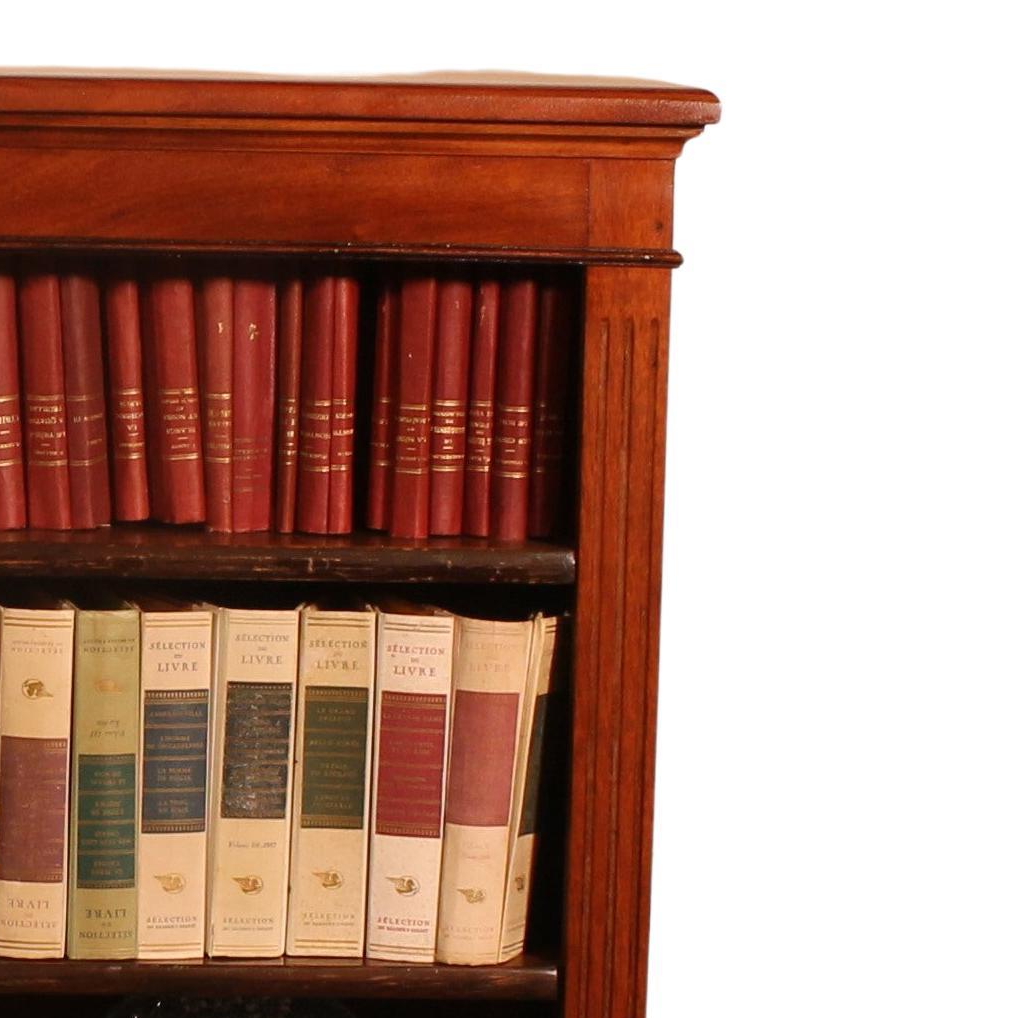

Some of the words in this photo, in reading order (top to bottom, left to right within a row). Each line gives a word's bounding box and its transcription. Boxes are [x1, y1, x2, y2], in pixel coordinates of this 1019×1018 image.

[241, 655, 282, 664] LIVRE
[316, 659, 358, 671] LIVRE
[157, 661, 198, 672] LIVRE
[393, 664, 436, 676] LIVRE
[8, 899, 49, 909] LIVRE
[86, 908, 126, 919] LIVRE
